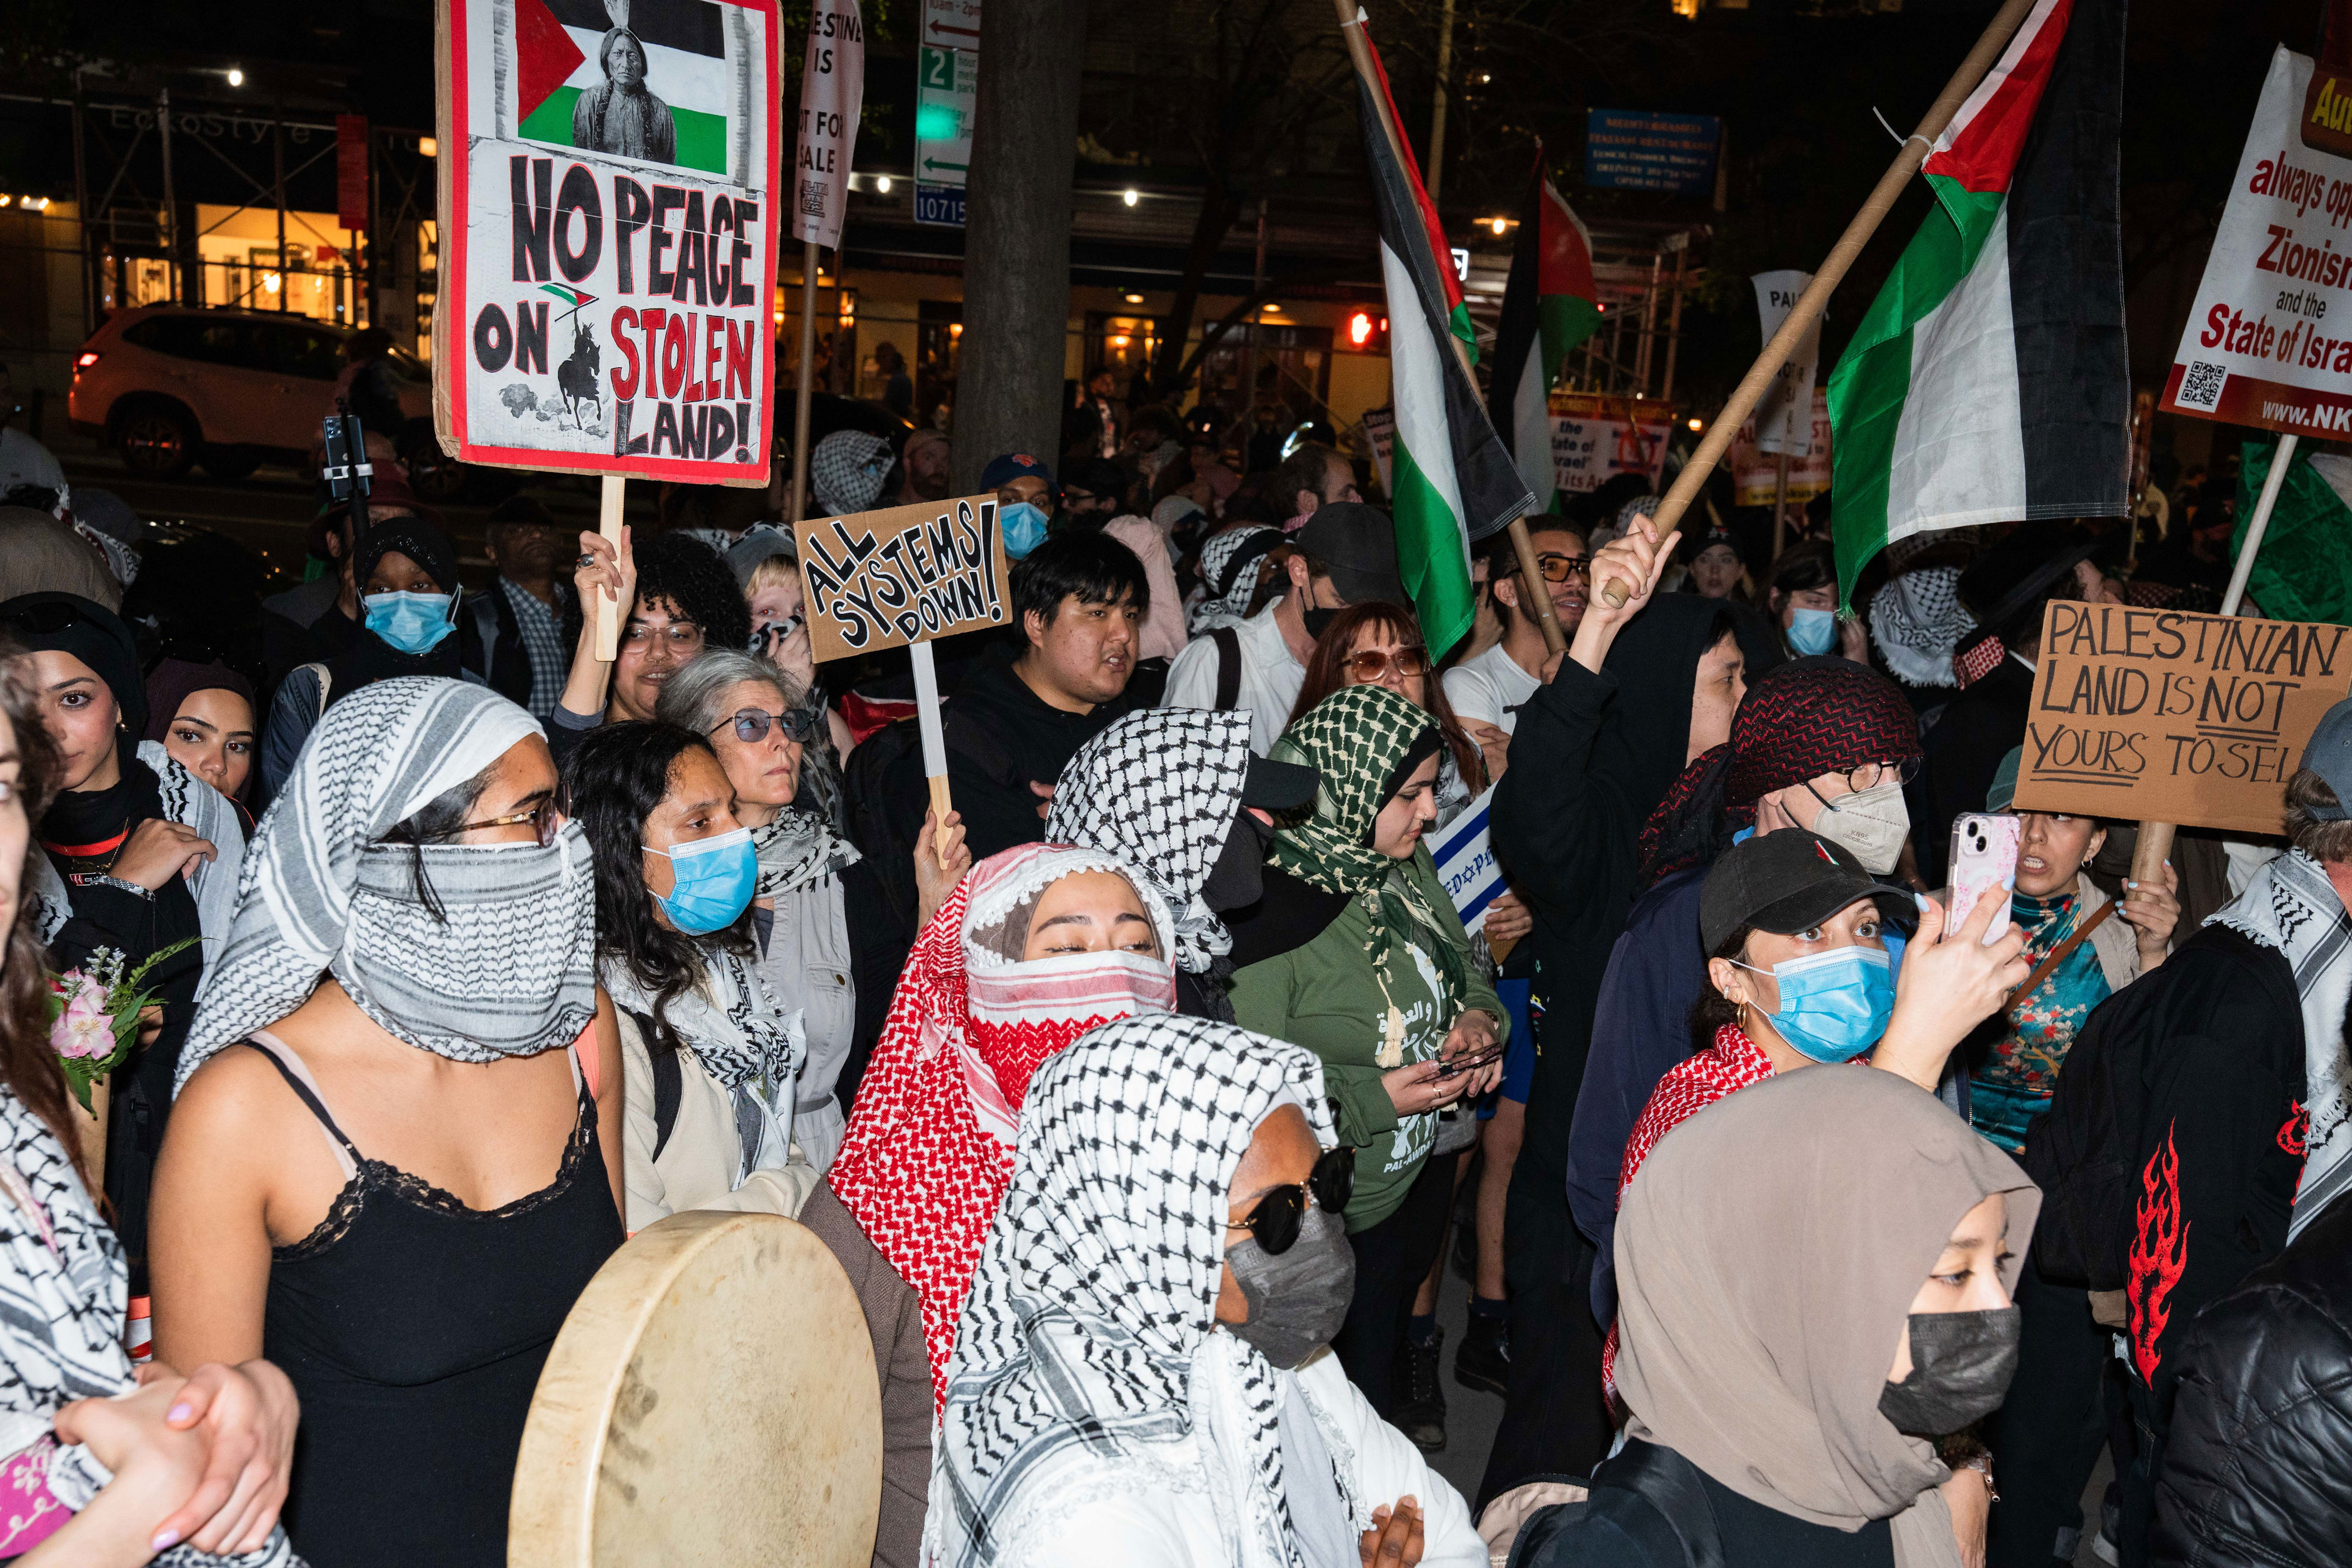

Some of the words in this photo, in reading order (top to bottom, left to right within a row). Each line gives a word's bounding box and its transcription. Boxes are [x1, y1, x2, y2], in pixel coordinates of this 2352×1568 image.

[811, 11, 862, 43] ESTINE
[814, 48, 833, 74] IS
[929, 50, 946, 85] 2
[816, 111, 843, 139] FOR
[800, 144, 835, 173] SALE
[2250, 150, 2326, 218] always
[509, 155, 603, 283] NO
[615, 175, 758, 307] PEACE
[2200, 303, 2275, 359] State
[2277, 320, 2303, 363] of
[2276, 290, 2304, 314] and
[2303, 292, 2326, 319] the
[473, 300, 550, 375] ON
[611, 306, 755, 403] STOLEN
[615, 400, 750, 464] LAND!
[804, 520, 879, 616] ALL
[2048, 604, 2349, 677] PALESTINIAN
[2041, 659, 2149, 716] LAND
[2155, 673, 2195, 716] IS
[2197, 676, 2301, 731] NOT
[2029, 723, 2149, 773] YOURS
[2165, 733, 2214, 775] TO
[2217, 743, 2306, 783] SEL
[1851, 830, 1869, 840] KN95
